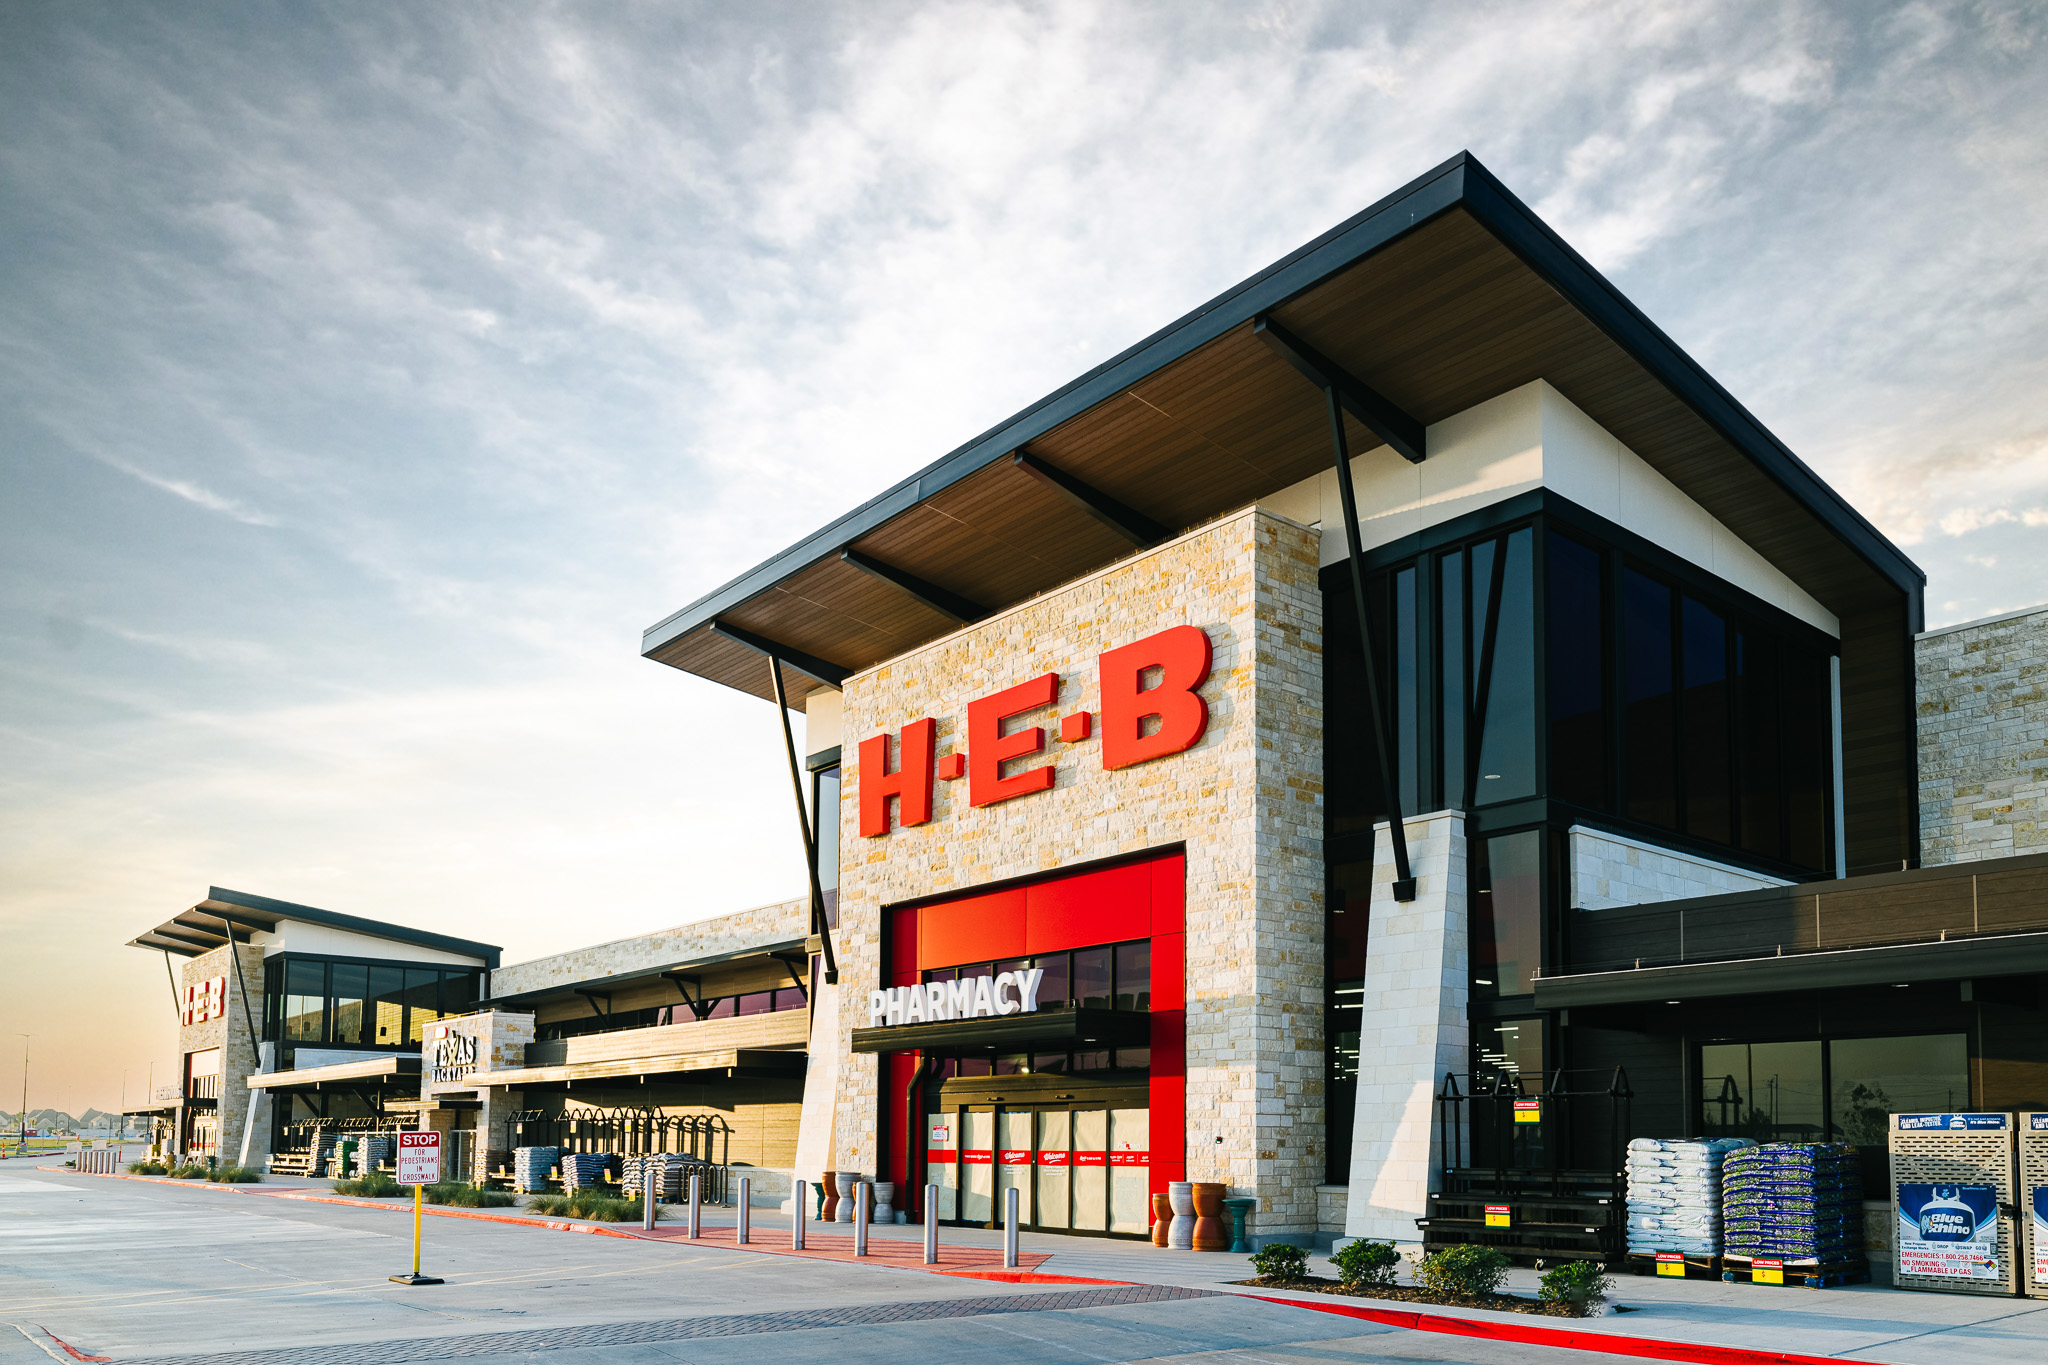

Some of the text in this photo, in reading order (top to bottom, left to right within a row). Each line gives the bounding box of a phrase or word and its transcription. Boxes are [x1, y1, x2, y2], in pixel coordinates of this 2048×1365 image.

[870, 969, 1044, 1027] PHARMACY
[432, 1031, 476, 1067] TEXAS
[403, 1134, 437, 1145] STOP
[1931, 1213, 1964, 1224] Blue
[1928, 1224, 1970, 1234] Rhino
